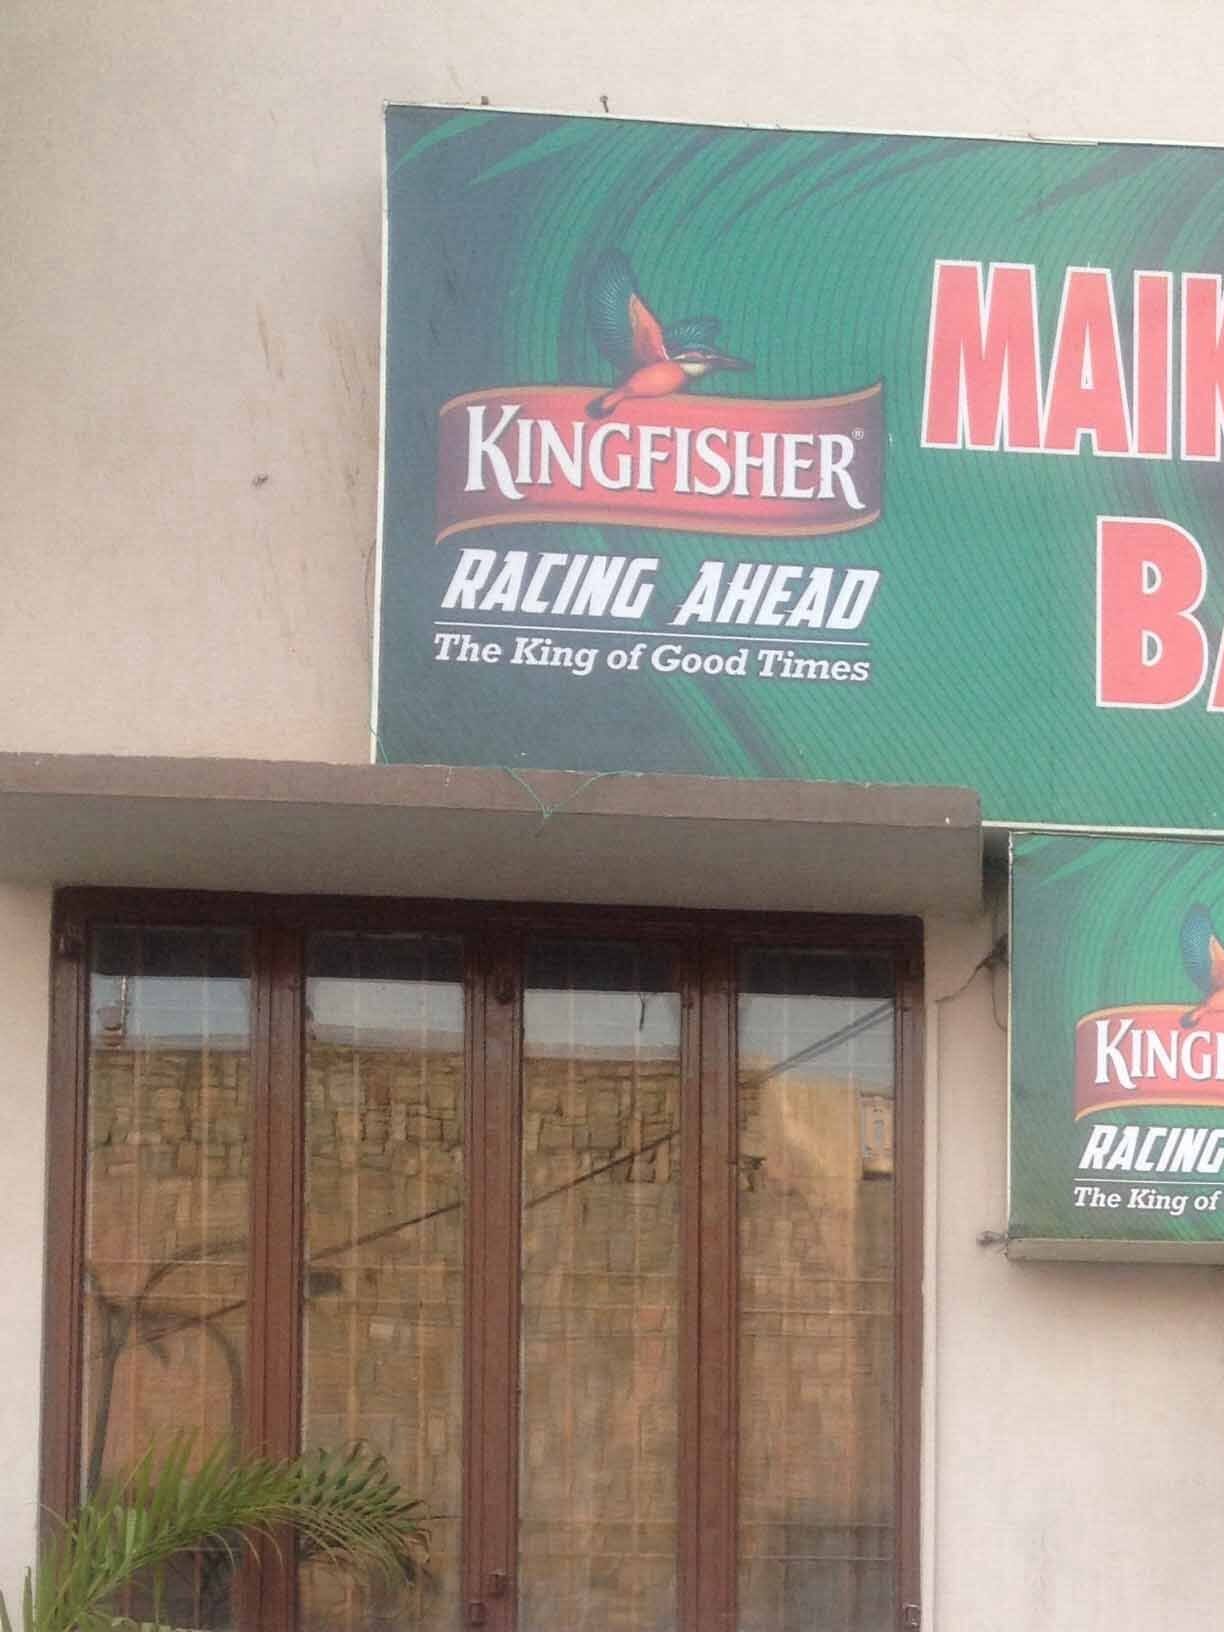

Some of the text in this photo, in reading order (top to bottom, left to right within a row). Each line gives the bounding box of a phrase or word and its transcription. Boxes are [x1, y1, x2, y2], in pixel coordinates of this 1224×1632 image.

[463, 403, 866, 510] KINGFISHER
[441, 547, 880, 630] RACING AHEAD
[434, 632, 870, 681] The King of Good Times
[1074, 1186, 1121, 1209] The
[1127, 1189, 1186, 1216] King
[1194, 1191, 1224, 1211] of
